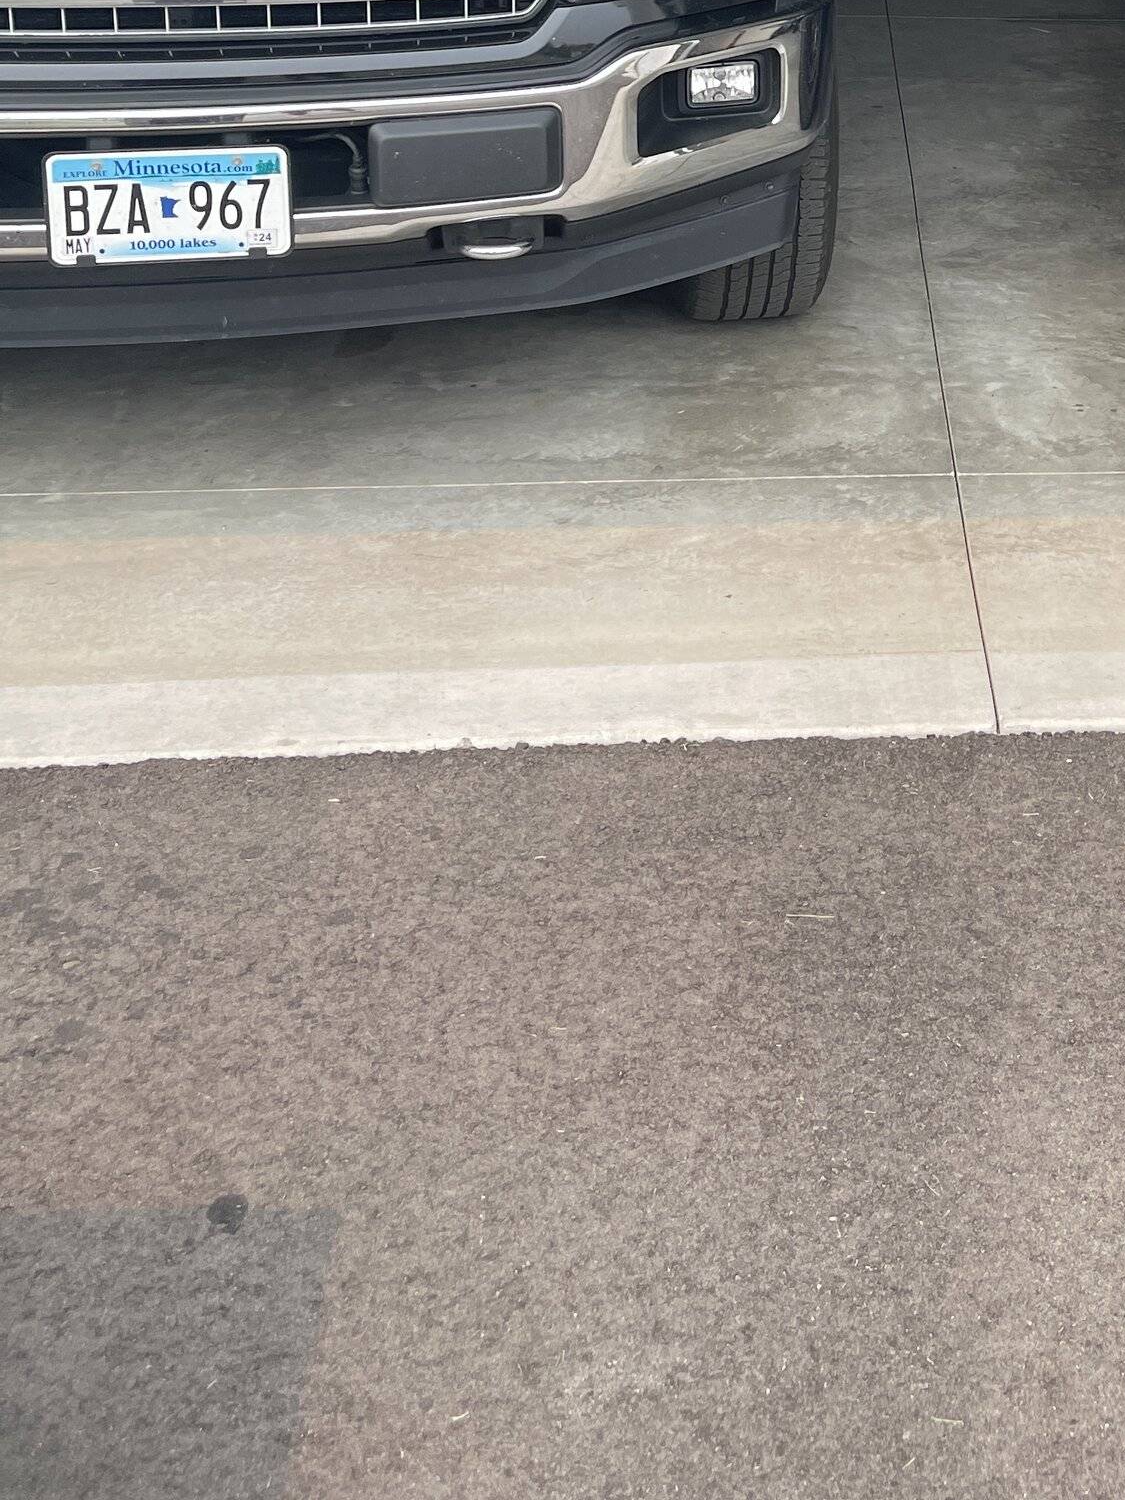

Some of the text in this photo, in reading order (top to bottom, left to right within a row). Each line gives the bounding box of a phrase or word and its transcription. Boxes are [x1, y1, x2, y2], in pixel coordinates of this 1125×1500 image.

[63, 158, 253, 178] EXPLORE Minnesota.com
[63, 178, 271, 237] BZA 967
[65, 237, 91, 255] MAY
[129, 237, 217, 251] 10,000 lakes
[258, 233, 272, 242] 24
